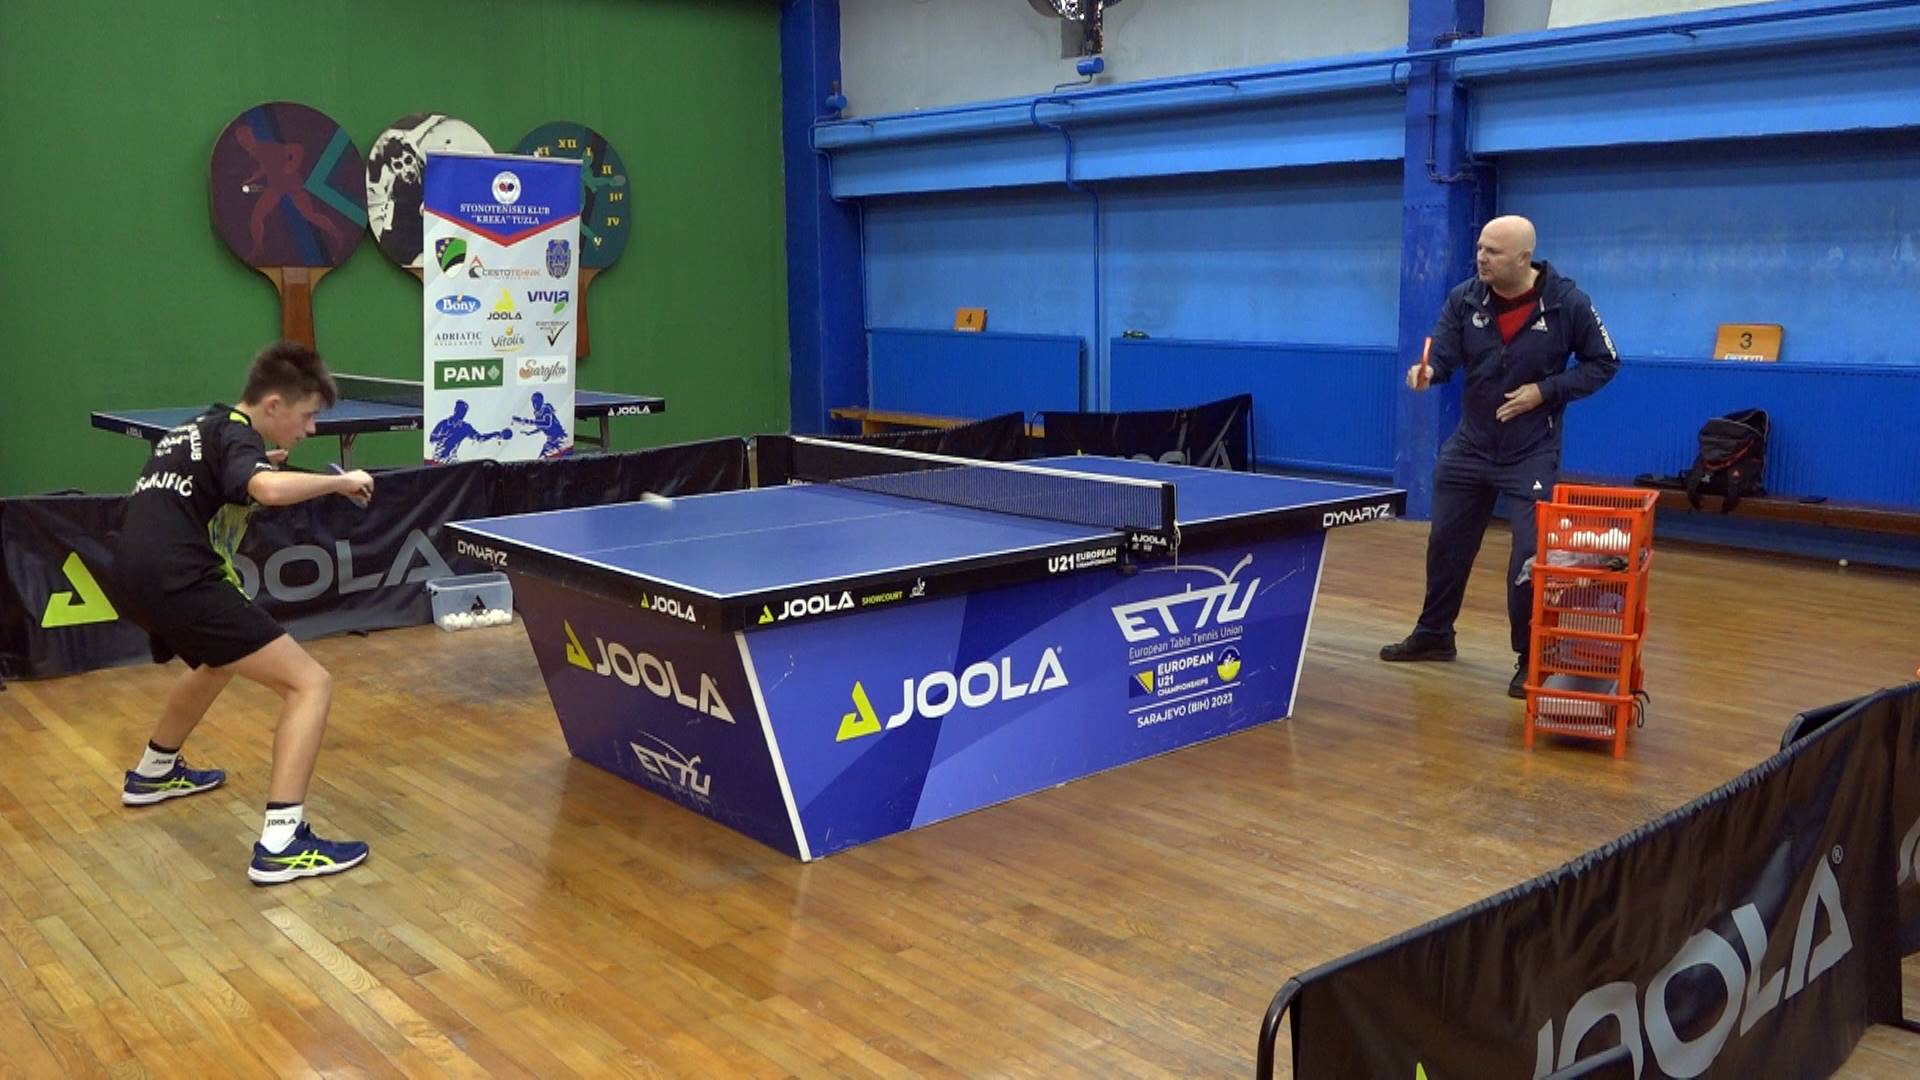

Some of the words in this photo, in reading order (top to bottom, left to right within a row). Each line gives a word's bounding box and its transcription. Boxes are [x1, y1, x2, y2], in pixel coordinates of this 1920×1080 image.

[558, 138, 577, 149] XII
[460, 203, 526, 214] STONOTENISKI
[527, 206, 550, 215] KLUB
[512, 215, 540, 225] TUZLA
[607, 216, 620, 226] IV
[487, 311, 522, 320] JOOLA
[966, 312, 973, 325] 4
[435, 331, 482, 341] ADRIATIC
[1740, 331, 1753, 350] 3
[443, 365, 485, 382] PAN
[615, 404, 651, 416] JOOLA
[1322, 503, 1391, 528] DYNARYZ
[1139, 533, 1168, 546] JOOLA
[457, 540, 508, 567] DYNARYZ
[1047, 553, 1076, 573] U21
[1076, 547, 1117, 562] EUROPEAN
[651, 594, 697, 622] JOOLA
[777, 591, 856, 621] JOOLA
[1111, 577, 1261, 643] ETTU
[1128, 642, 1169, 660] European
[1171, 637, 1192, 649] Table
[1193, 630, 1219, 643] Tennis
[1220, 625, 1243, 638] Union
[1157, 651, 1214, 676] EUROPEAN
[594, 636, 737, 725] JOOLA
[885, 646, 1069, 730] JOOLA
[1157, 675, 1174, 688] U21
[1157, 677, 1209, 697] CHAMPIONSHIPS
[1137, 705, 1186, 728] SARAJEVO
[1187, 696, 1210, 715] (BIH)
[267, 817, 297, 828] JOOLA
